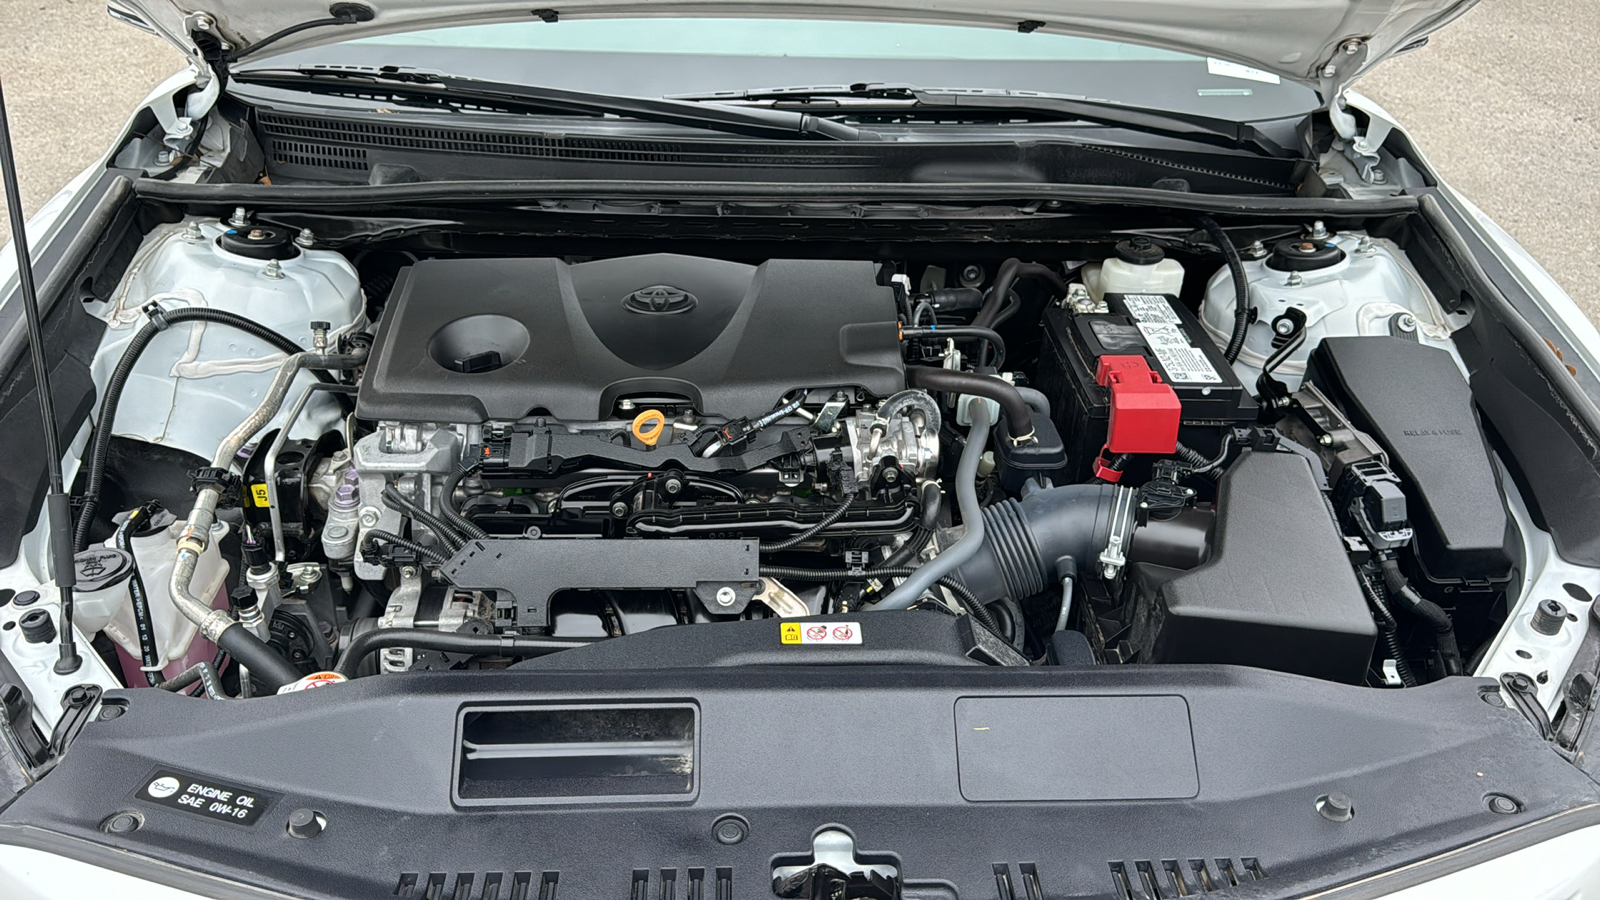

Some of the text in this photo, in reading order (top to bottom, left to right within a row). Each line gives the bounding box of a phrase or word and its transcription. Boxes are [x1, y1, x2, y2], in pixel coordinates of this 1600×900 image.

[255, 489, 268, 502] J5
[178, 794, 249, 818] SAE 0W-16
[187, 783, 255, 808] ENGINE OIL
